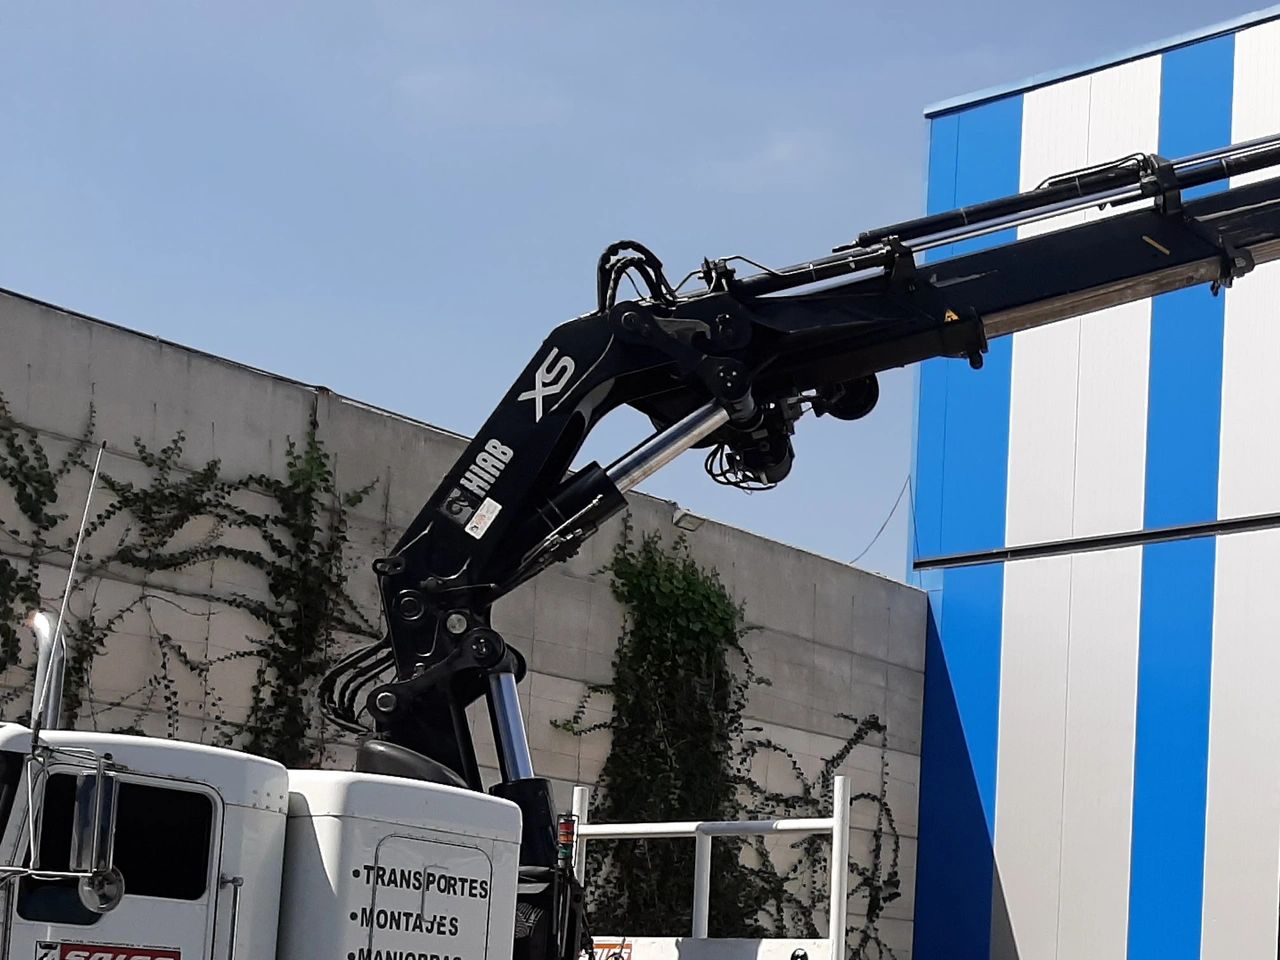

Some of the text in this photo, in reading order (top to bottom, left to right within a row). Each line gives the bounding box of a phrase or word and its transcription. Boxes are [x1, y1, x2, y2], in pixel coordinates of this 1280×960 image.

[517, 346, 576, 423] XS
[459, 438, 514, 498] HIAB
[363, 864, 489, 899] TRANSPORTES
[360, 907, 459, 936] MONTAJES
